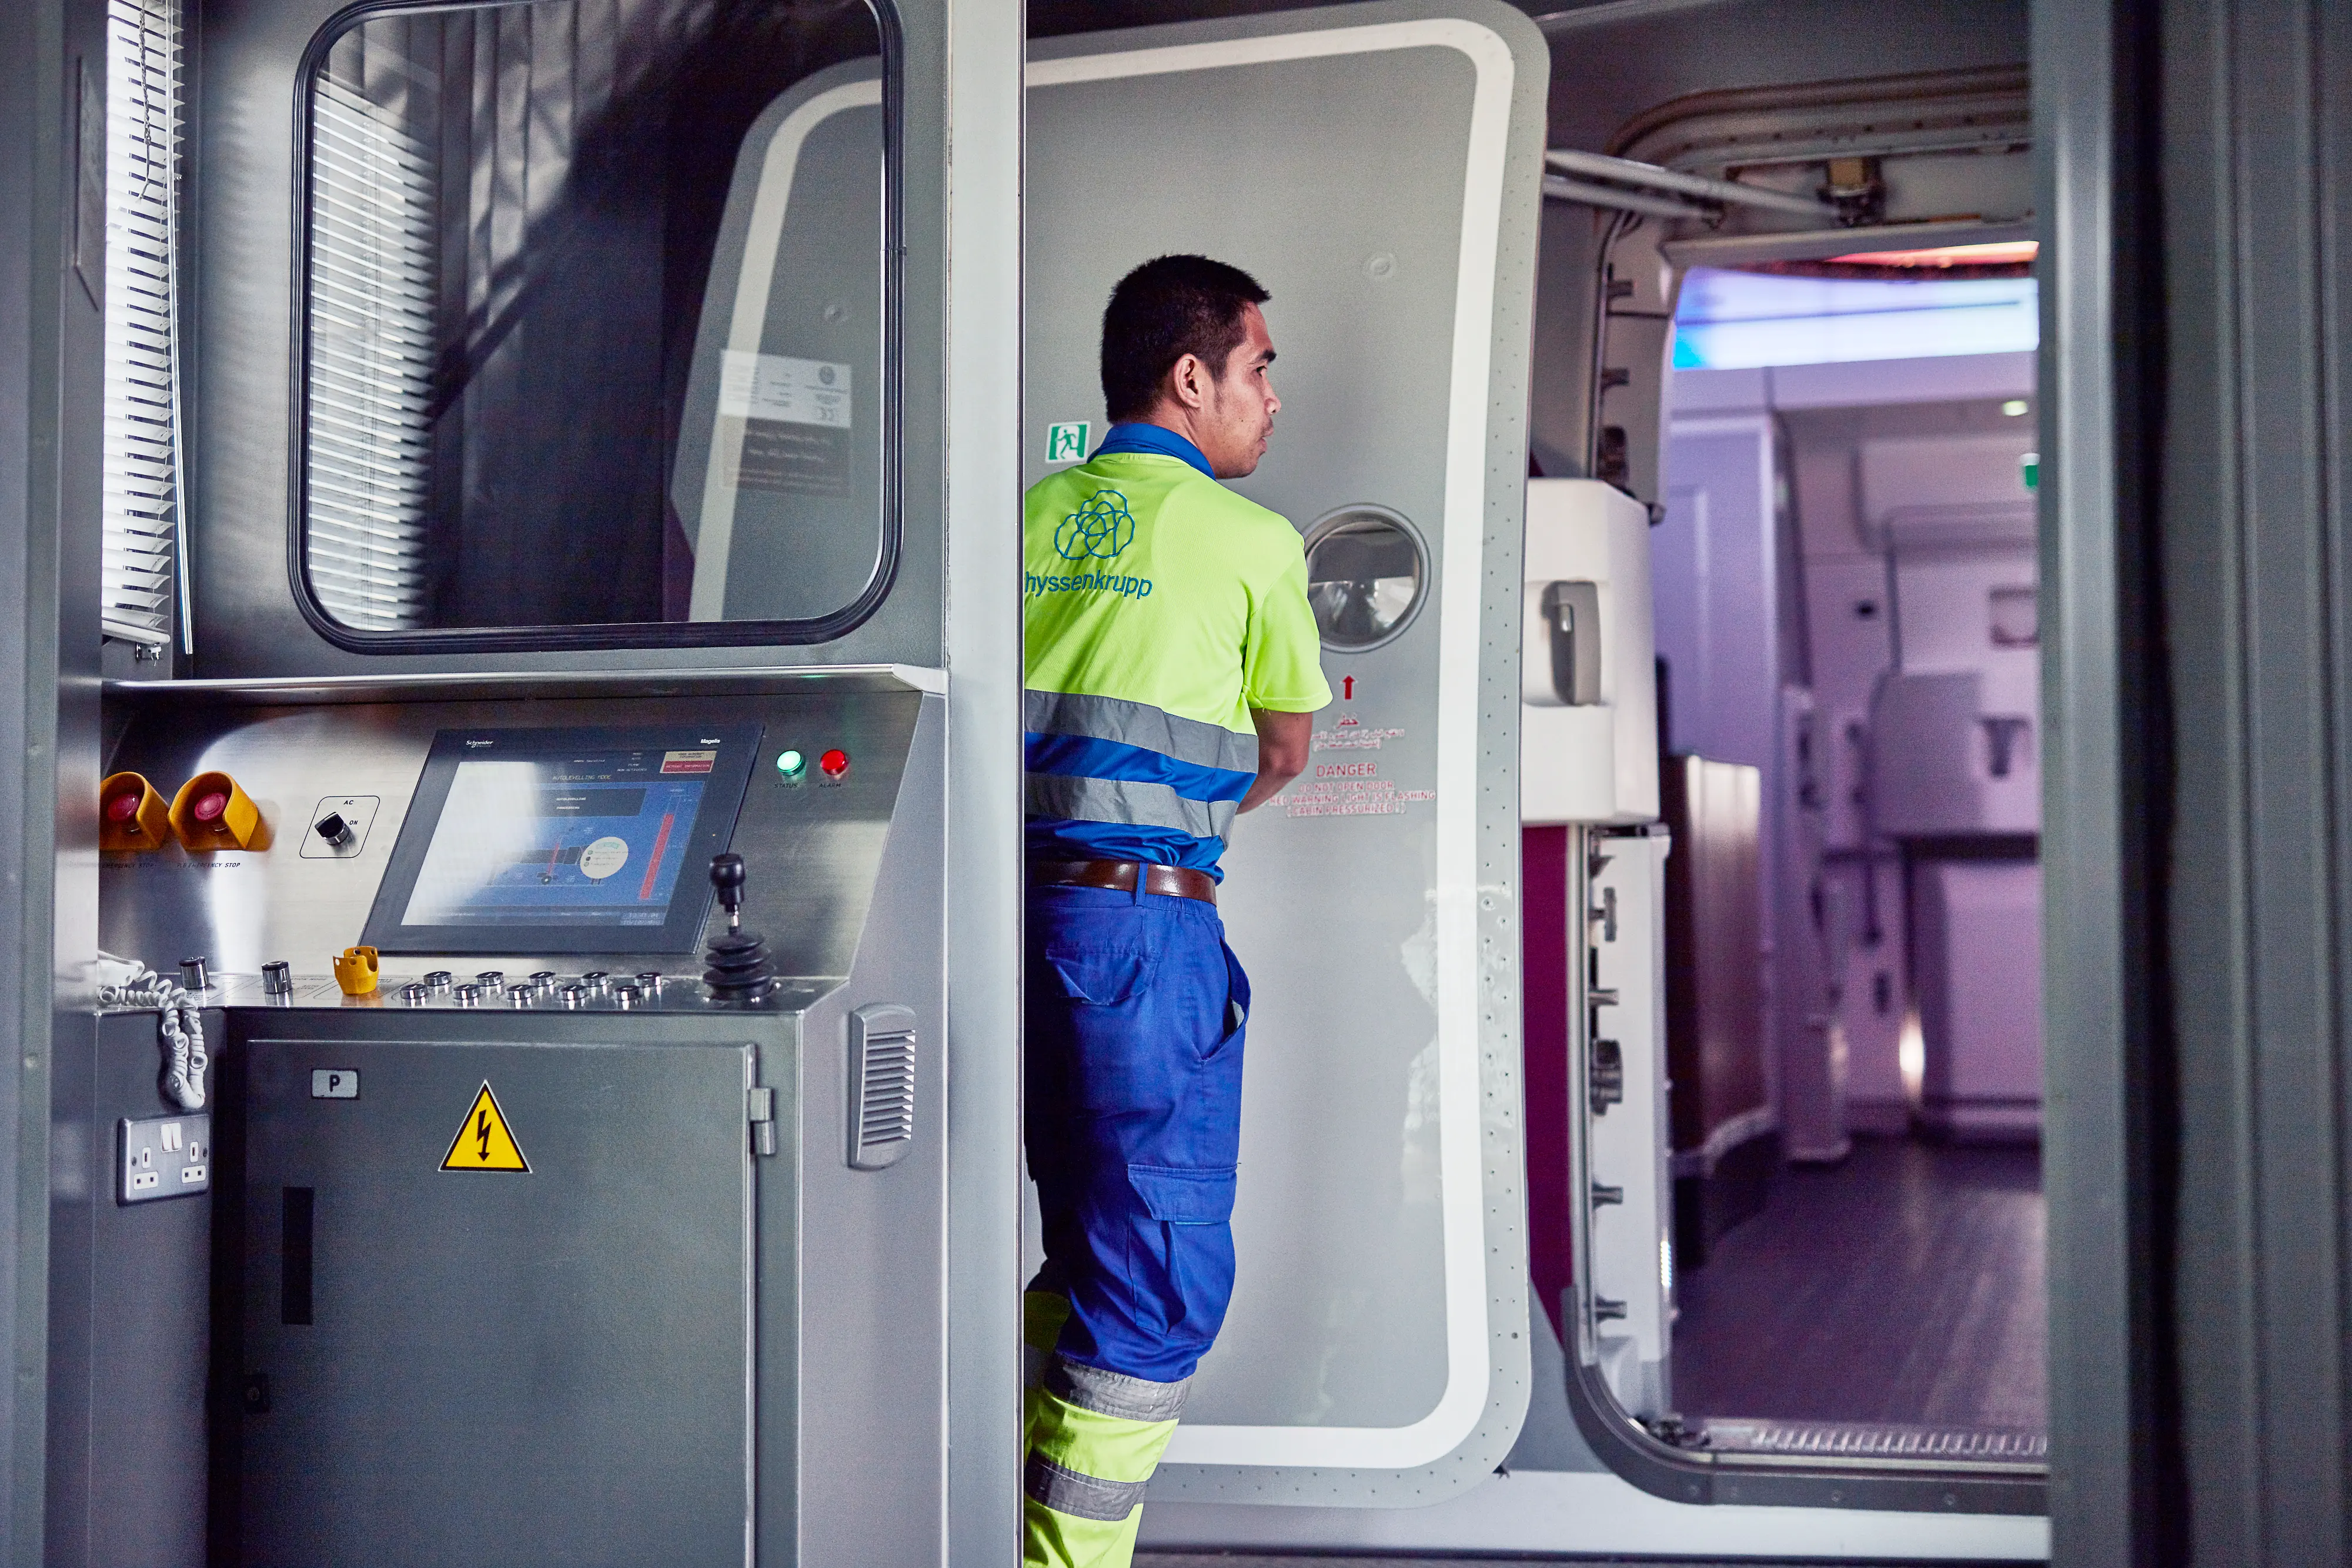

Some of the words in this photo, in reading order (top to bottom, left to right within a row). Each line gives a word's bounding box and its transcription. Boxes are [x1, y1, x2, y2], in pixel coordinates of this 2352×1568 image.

[1024, 570, 1152, 600] hyssenkrupp
[1317, 764, 1377, 777] DANGER
[1315, 782, 1334, 792] NOT
[1337, 781, 1364, 791] OPEN
[1367, 781, 1394, 790] DOOR
[1293, 794, 1339, 805] WARNING
[1342, 793, 1369, 803] LIGHT
[1372, 792, 1382, 803] IS
[1385, 791, 1435, 801] FLASHING
[329, 1074, 341, 1092] P
